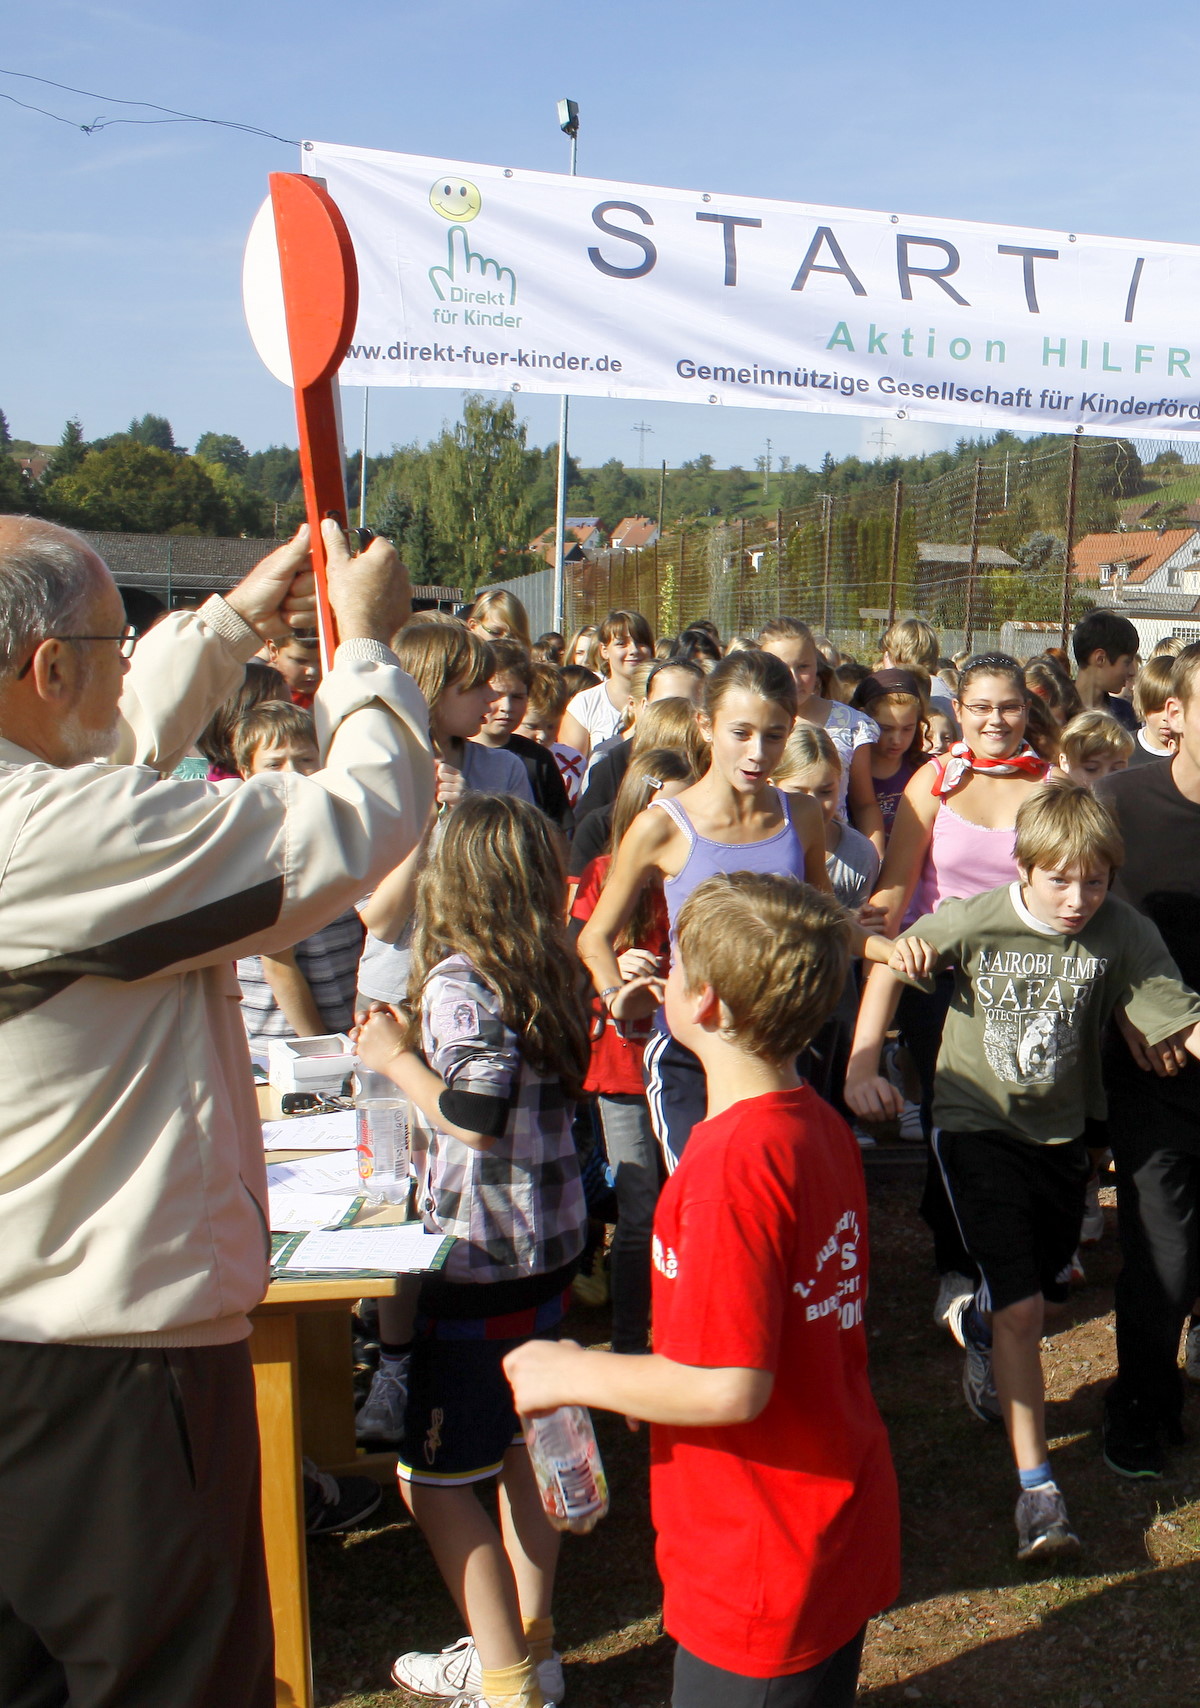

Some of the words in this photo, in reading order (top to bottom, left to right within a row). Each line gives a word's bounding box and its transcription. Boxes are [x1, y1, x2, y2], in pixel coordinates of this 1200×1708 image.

[587, 200, 1058, 313] START
[450, 286, 505, 306] Direkt
[433, 308, 458, 325] für
[464, 309, 523, 328] Kinder
[345, 341, 623, 373] ww.direkt-fuer-kinder.de
[827, 321, 1006, 364] Aktion
[676, 359, 870, 394] Gemeinnützige
[876, 376, 1031, 410] Gesellschaft
[1039, 389, 1074, 411] für
[978, 951, 1054, 975] NAIROBI
